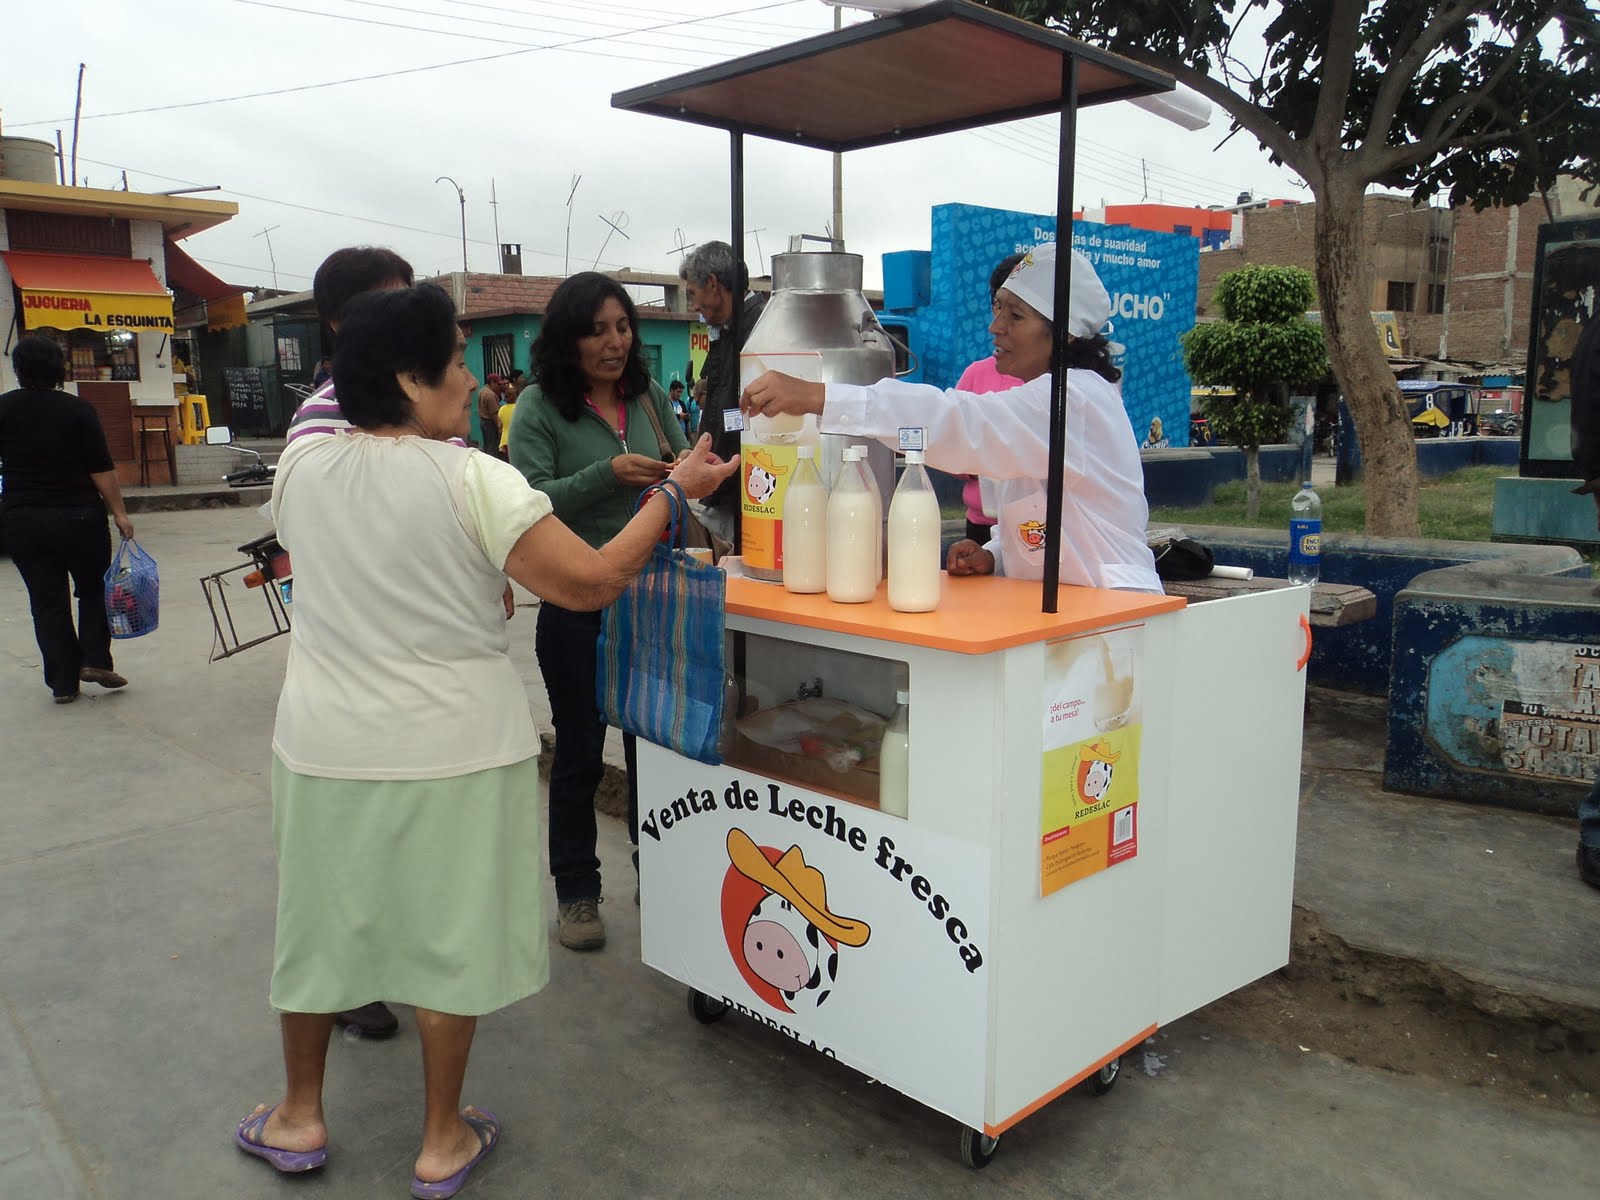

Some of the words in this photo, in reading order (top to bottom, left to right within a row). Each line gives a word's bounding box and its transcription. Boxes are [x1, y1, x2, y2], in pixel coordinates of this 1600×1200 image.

[1034, 227, 1055, 241] Dos
[1071, 231, 1087, 248] jas
[1089, 234, 1102, 246] de
[1104, 239, 1146, 252] suavidad
[1015, 243, 1039, 254] ace
[1094, 252, 1101, 264] y
[1103, 252, 1134, 265] mucho
[1137, 257, 1161, 269] amor
[24, 295, 92, 311] JUGUERIA
[1108, 292, 1171, 320] UCHO”
[84, 313, 102, 326] LA
[107, 314, 173, 328] ESQUINITA
[691, 333, 709, 353] PIQ
[743, 504, 775, 514] REDESLAC
[1050, 703, 1062, 714] ¡del
[1055, 712, 1062, 721] tu
[1521, 703, 1538, 715] TU
[1504, 719, 1558, 729] GENERAL
[1074, 800, 1110, 819] REDESLAC
[641, 787, 718, 842] Venta
[724, 780, 759, 811] de
[767, 784, 867, 852] Leche
[875, 837, 983, 974] fresca
